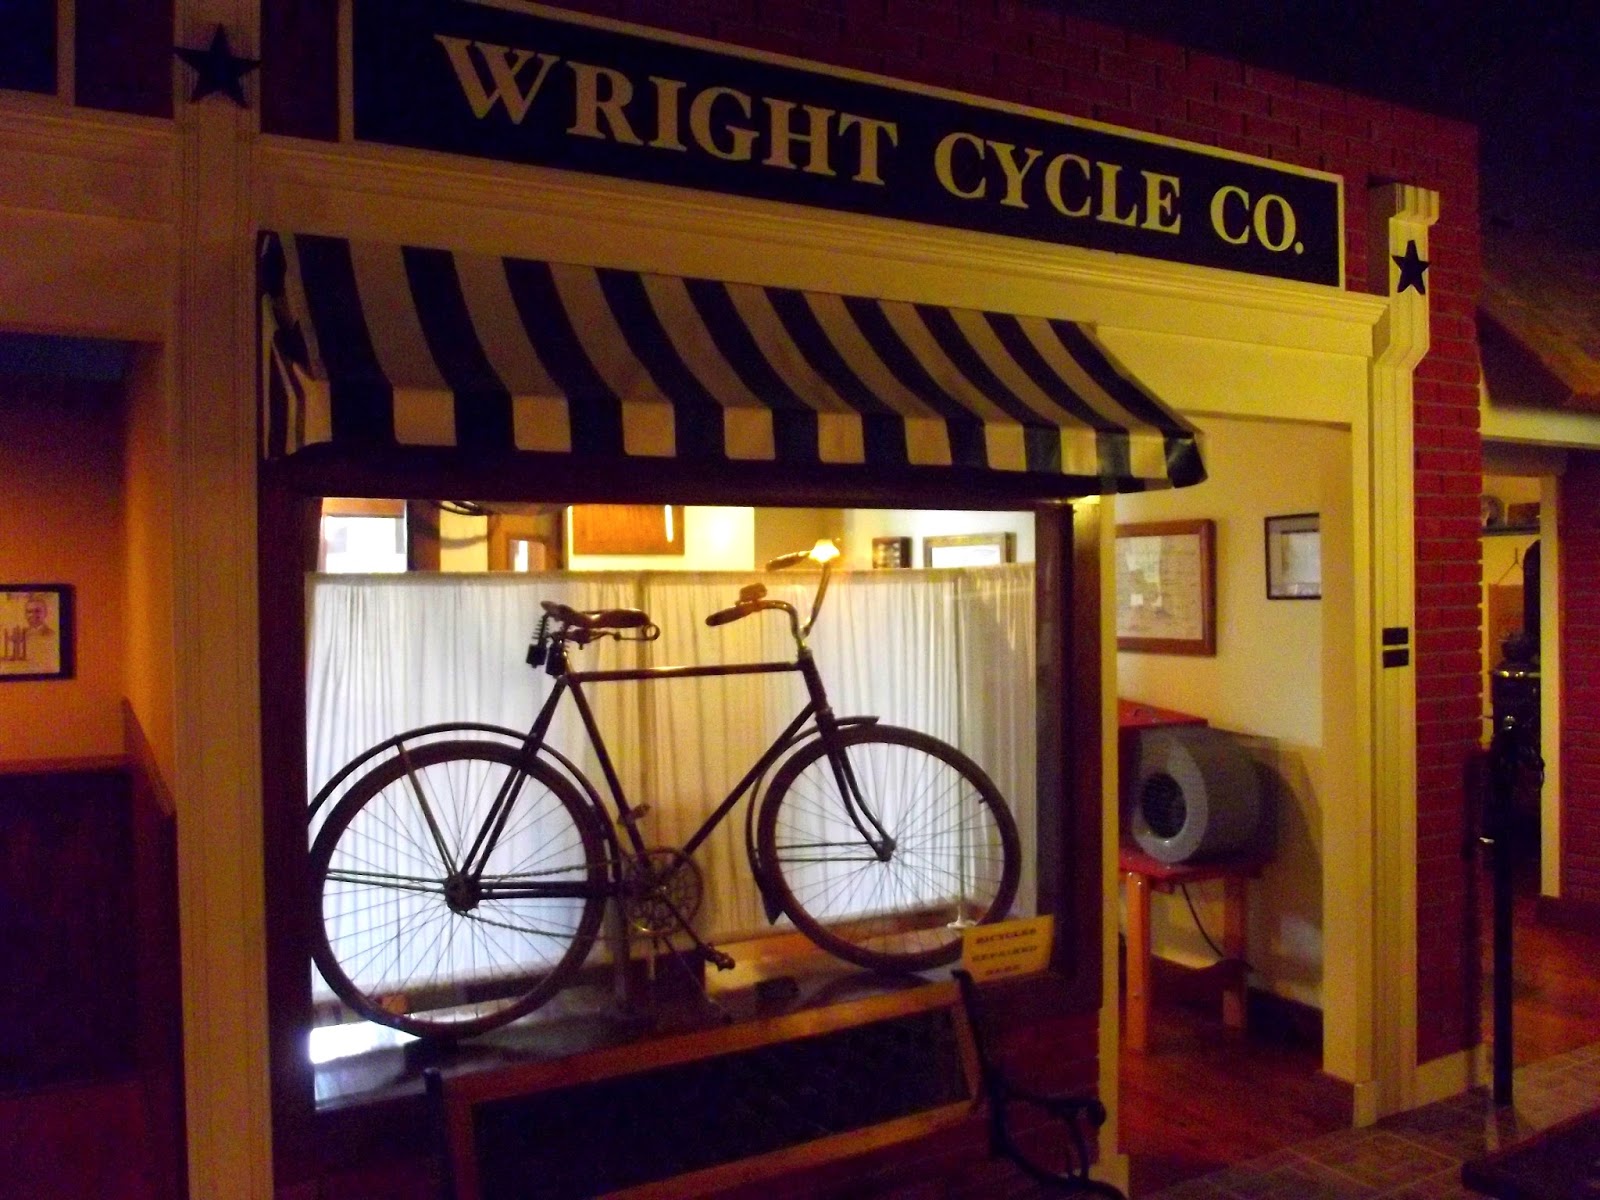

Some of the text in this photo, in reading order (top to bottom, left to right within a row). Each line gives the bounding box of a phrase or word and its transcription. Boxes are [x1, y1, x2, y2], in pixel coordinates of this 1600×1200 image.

[434, 34, 1304, 255] WRIGHT CYCLE CO.
